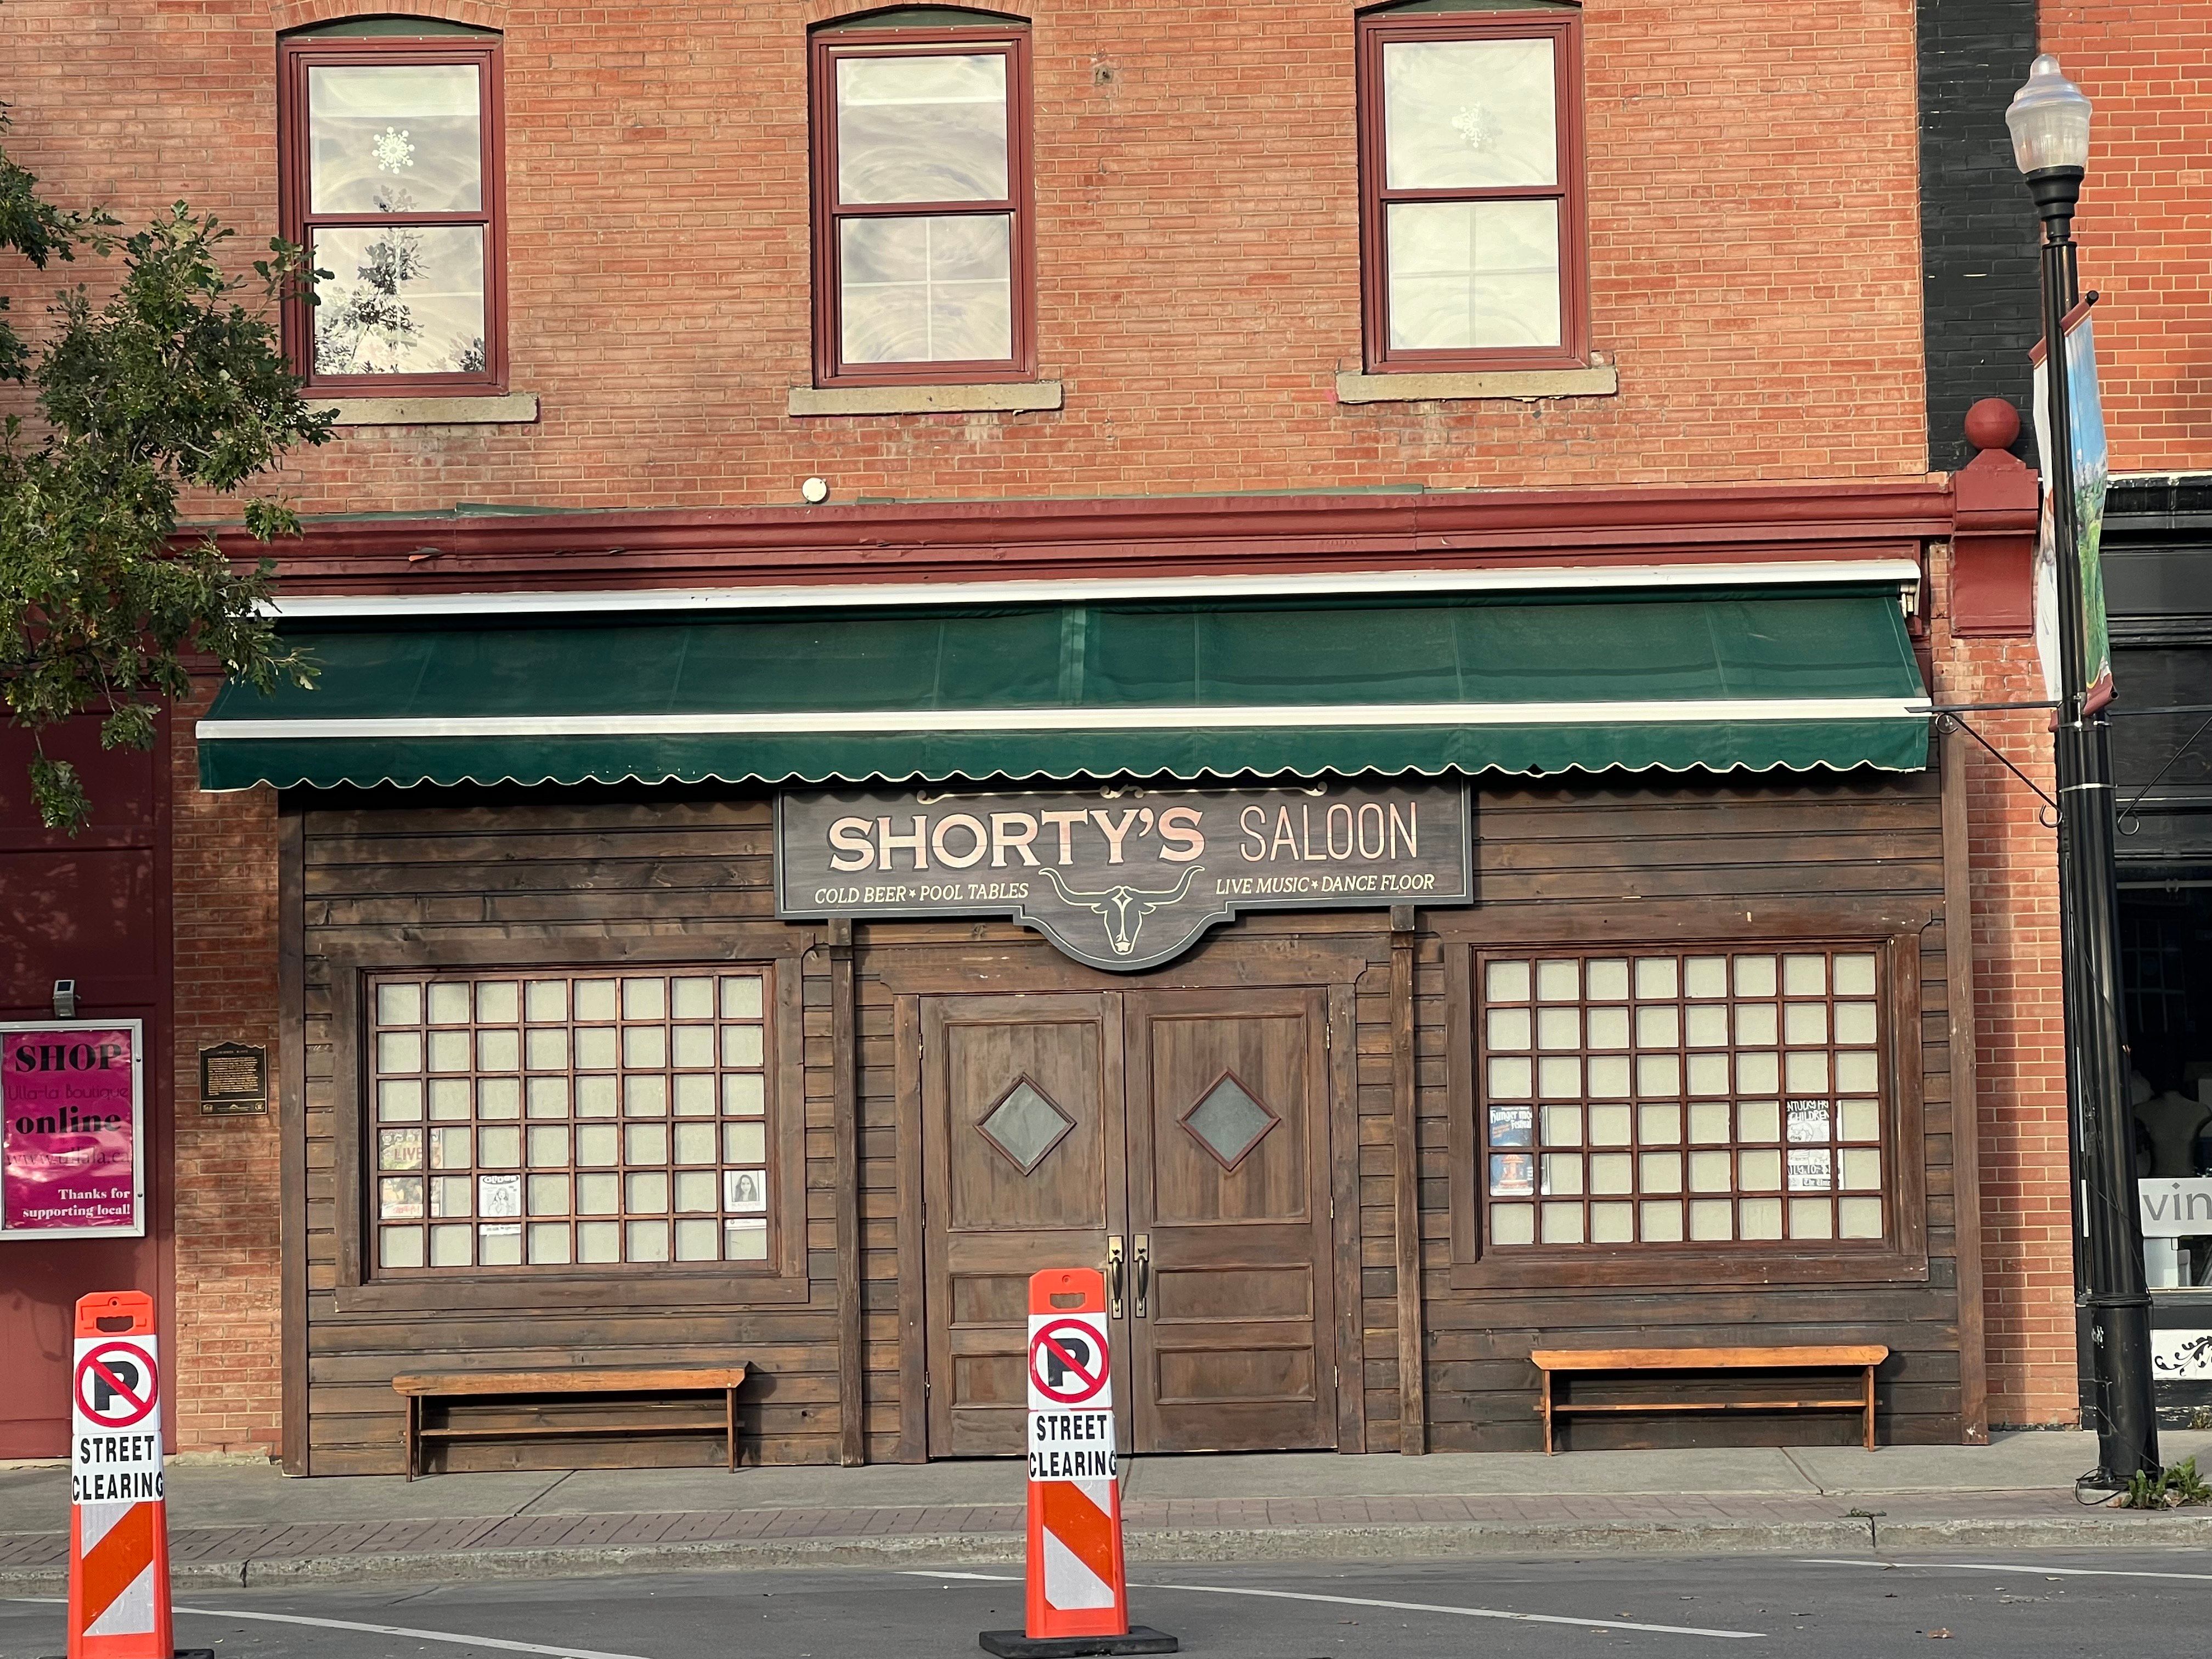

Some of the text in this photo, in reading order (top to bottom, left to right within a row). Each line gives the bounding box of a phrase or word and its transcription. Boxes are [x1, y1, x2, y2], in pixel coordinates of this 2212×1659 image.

[828, 802, 1418, 872] SHORTY'S SALOON
[814, 882, 1029, 905] COLD BEER POOL TABLES
[1215, 873, 1435, 895] LIVE MUSIC DANCE FLOOR
[15, 1043, 122, 1073] SHOP
[15, 1105, 121, 1135] online
[394, 1147, 422, 1161] LIVE
[58, 1187, 131, 1200] Thanks for
[2142, 1182, 2212, 1221] vin
[22, 1204, 131, 1220] supporting local!
[1036, 1415, 1107, 1441] STREET
[80, 1435, 155, 1464] STREET
[1029, 1450, 1117, 1478] CLEARING
[72, 1470, 164, 1502] CLEARING
